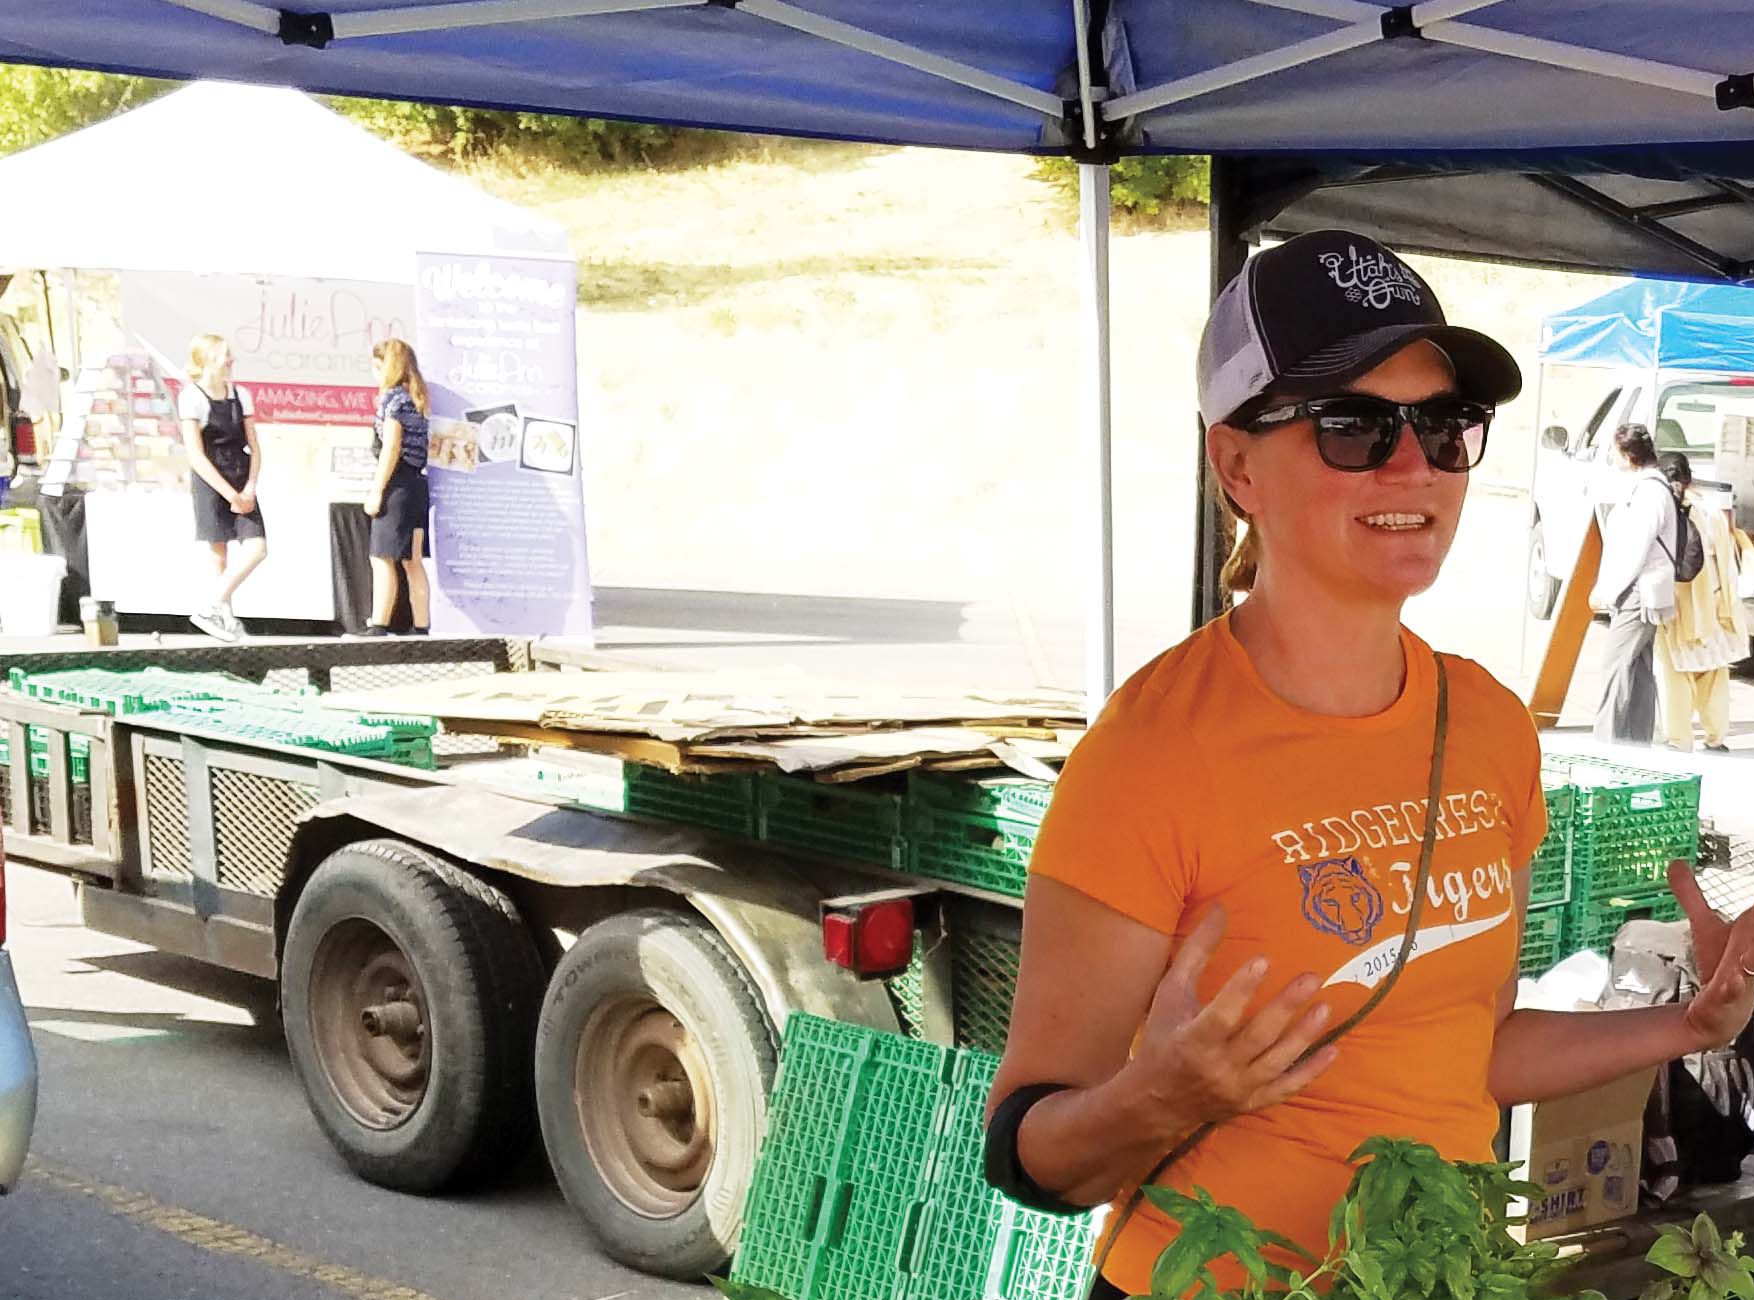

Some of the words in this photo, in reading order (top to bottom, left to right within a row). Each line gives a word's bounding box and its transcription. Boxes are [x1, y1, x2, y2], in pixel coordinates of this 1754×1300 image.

[421, 262, 566, 308] Welcome
[1362, 279, 1420, 309] Own
[266, 352, 371, 373] carame
[1389, 858, 1512, 921] Tigers
